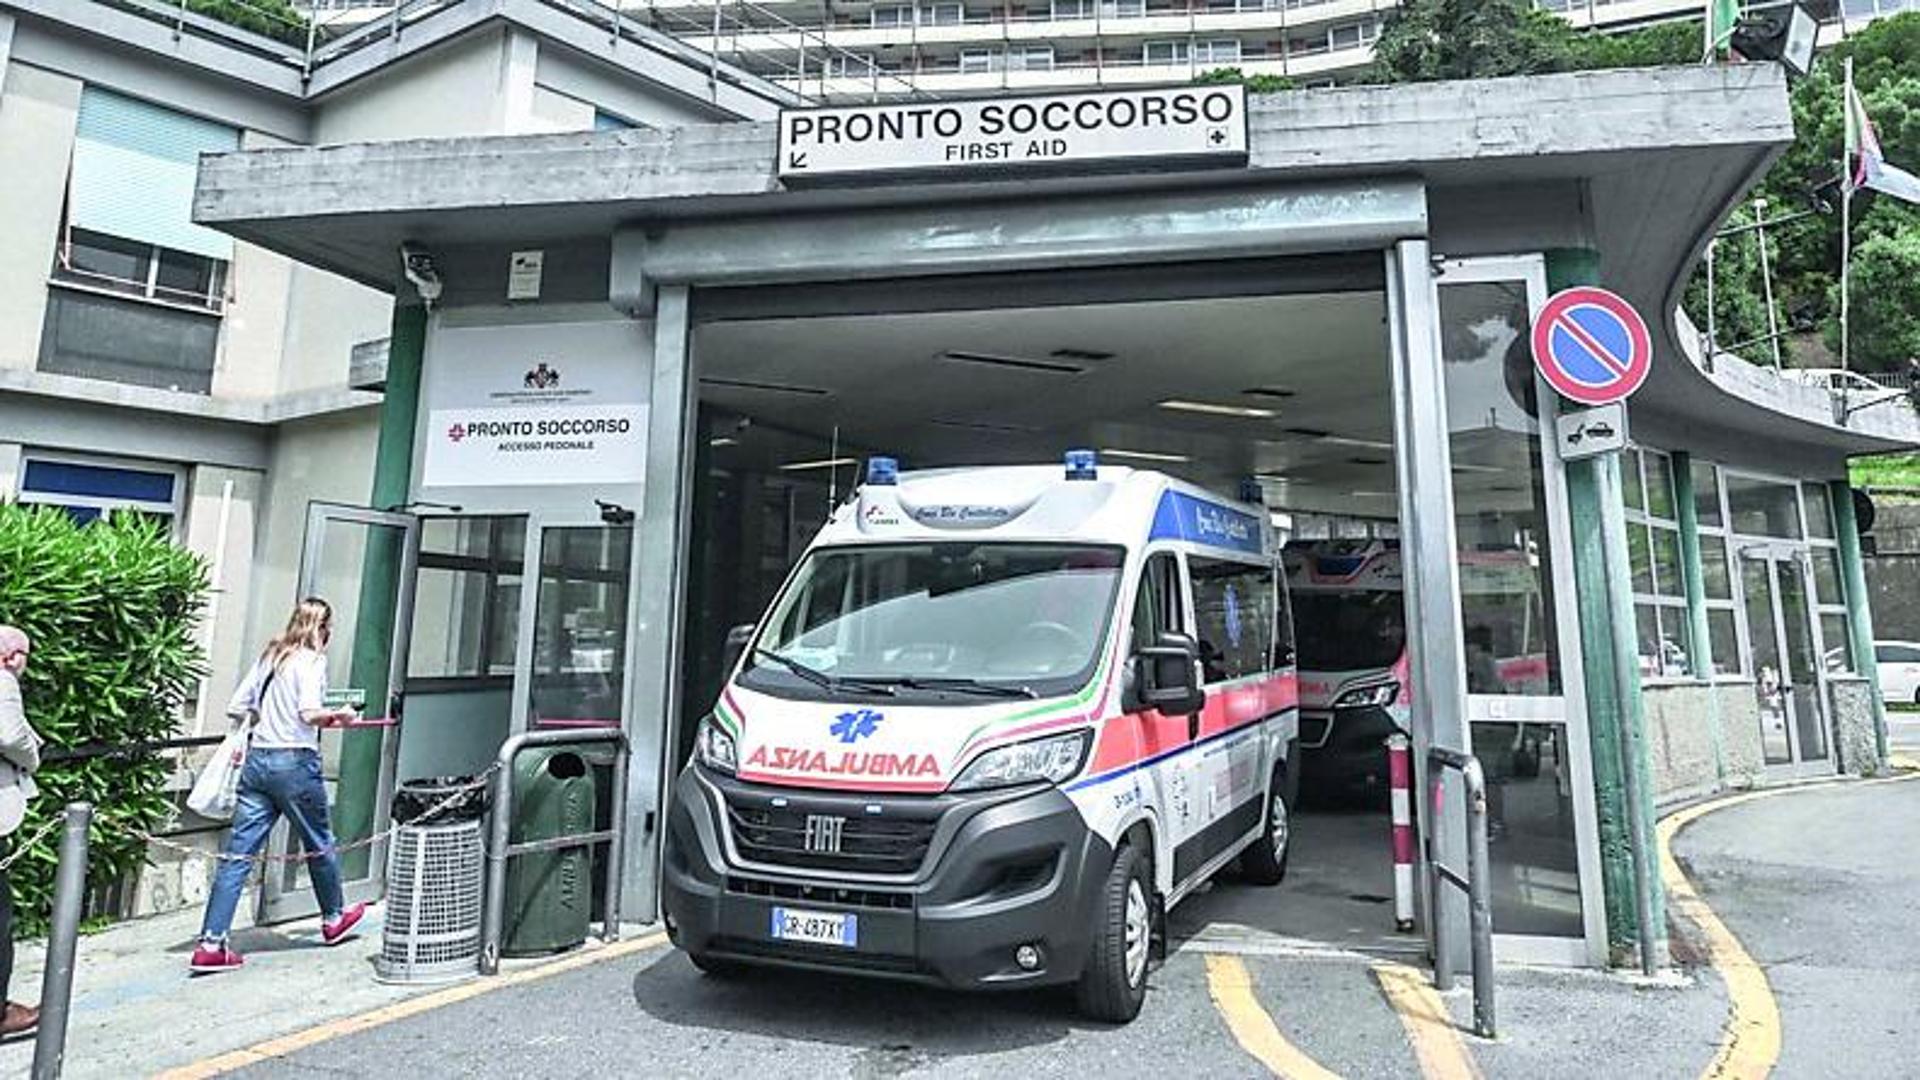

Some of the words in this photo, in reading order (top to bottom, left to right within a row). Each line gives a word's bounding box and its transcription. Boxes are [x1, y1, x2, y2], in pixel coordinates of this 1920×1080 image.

[790, 108, 962, 145] PRONTO
[979, 92, 1232, 136] SOCCORSO
[945, 141, 1013, 162] FIRST
[1026, 138, 1067, 157] AID
[467, 420, 533, 438] PRONTO
[537, 417, 630, 435] SOCCORSO
[497, 440, 541, 452] ACCESSO
[544, 440, 594, 451] PEDONALE
[805, 814, 846, 853] FIAT
